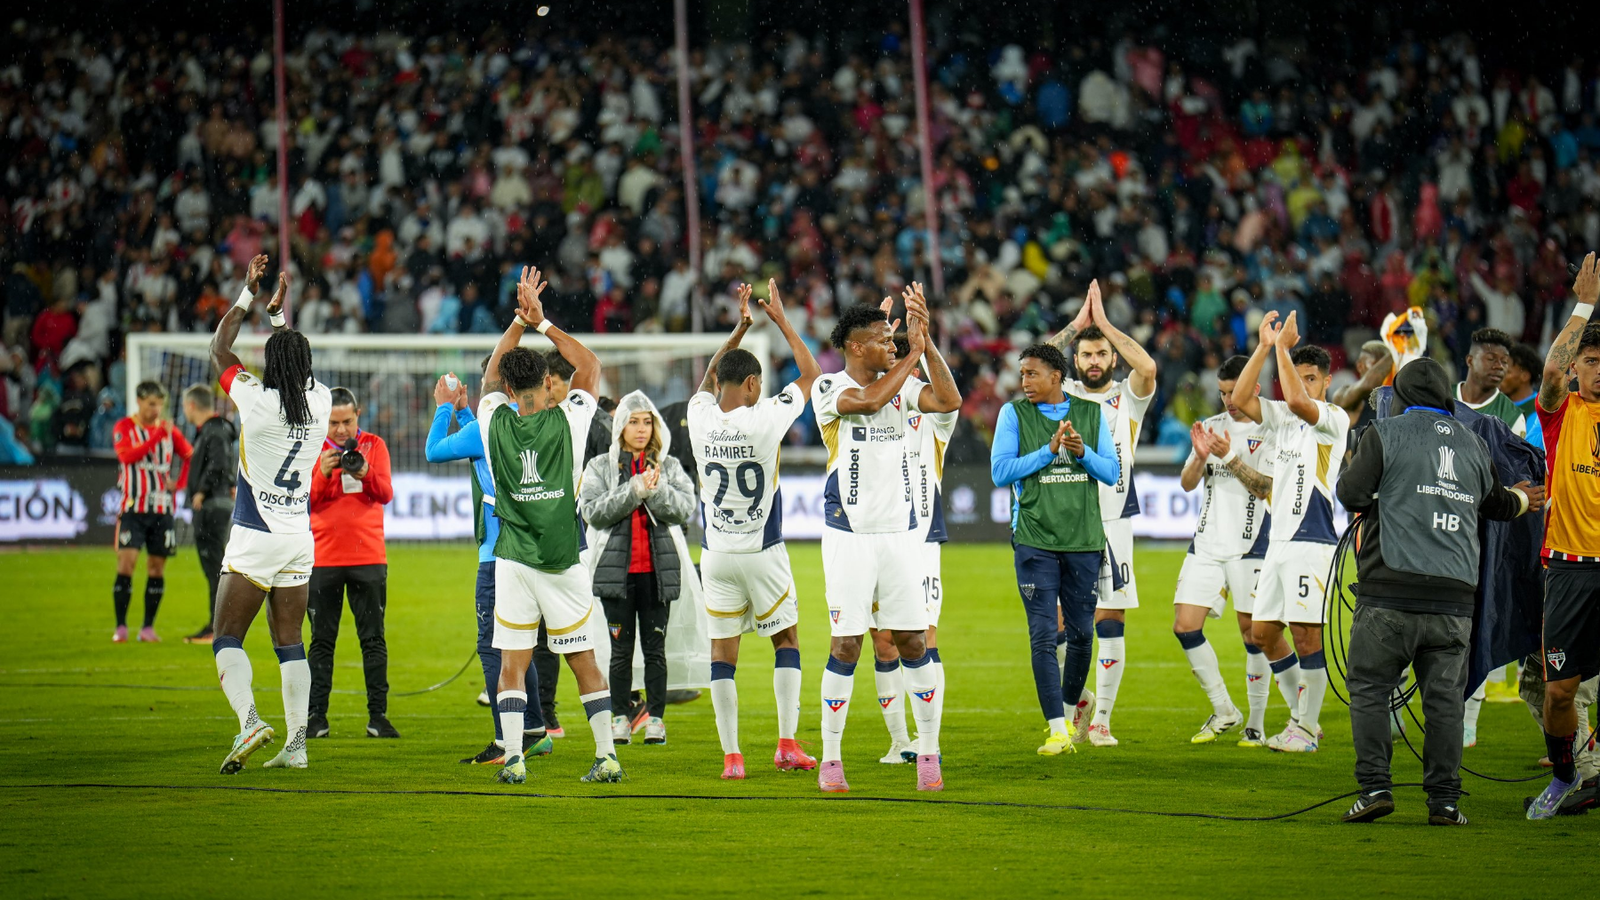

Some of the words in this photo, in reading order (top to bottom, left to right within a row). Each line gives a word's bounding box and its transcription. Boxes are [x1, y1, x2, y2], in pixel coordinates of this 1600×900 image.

[287, 429, 310, 441] ADE
[707, 430, 748, 443] Splendor
[1437, 425, 1451, 435] 09
[705, 446, 756, 459] RAMIREZ
[274, 441, 302, 492] 4
[847, 448, 860, 505] Ecuabet
[901, 445, 911, 502] Ecuabe
[1571, 463, 1600, 477] LIBERT
[705, 461, 765, 518] 29
[920, 464, 929, 518] Ecuabet
[1292, 464, 1305, 515] Ecuabet
[1416, 484, 1475, 504] LIBERTADORES
[1242, 491, 1257, 540] Ecuabe
[1433, 512, 1460, 532] HB
[1298, 575, 1309, 598] 5
